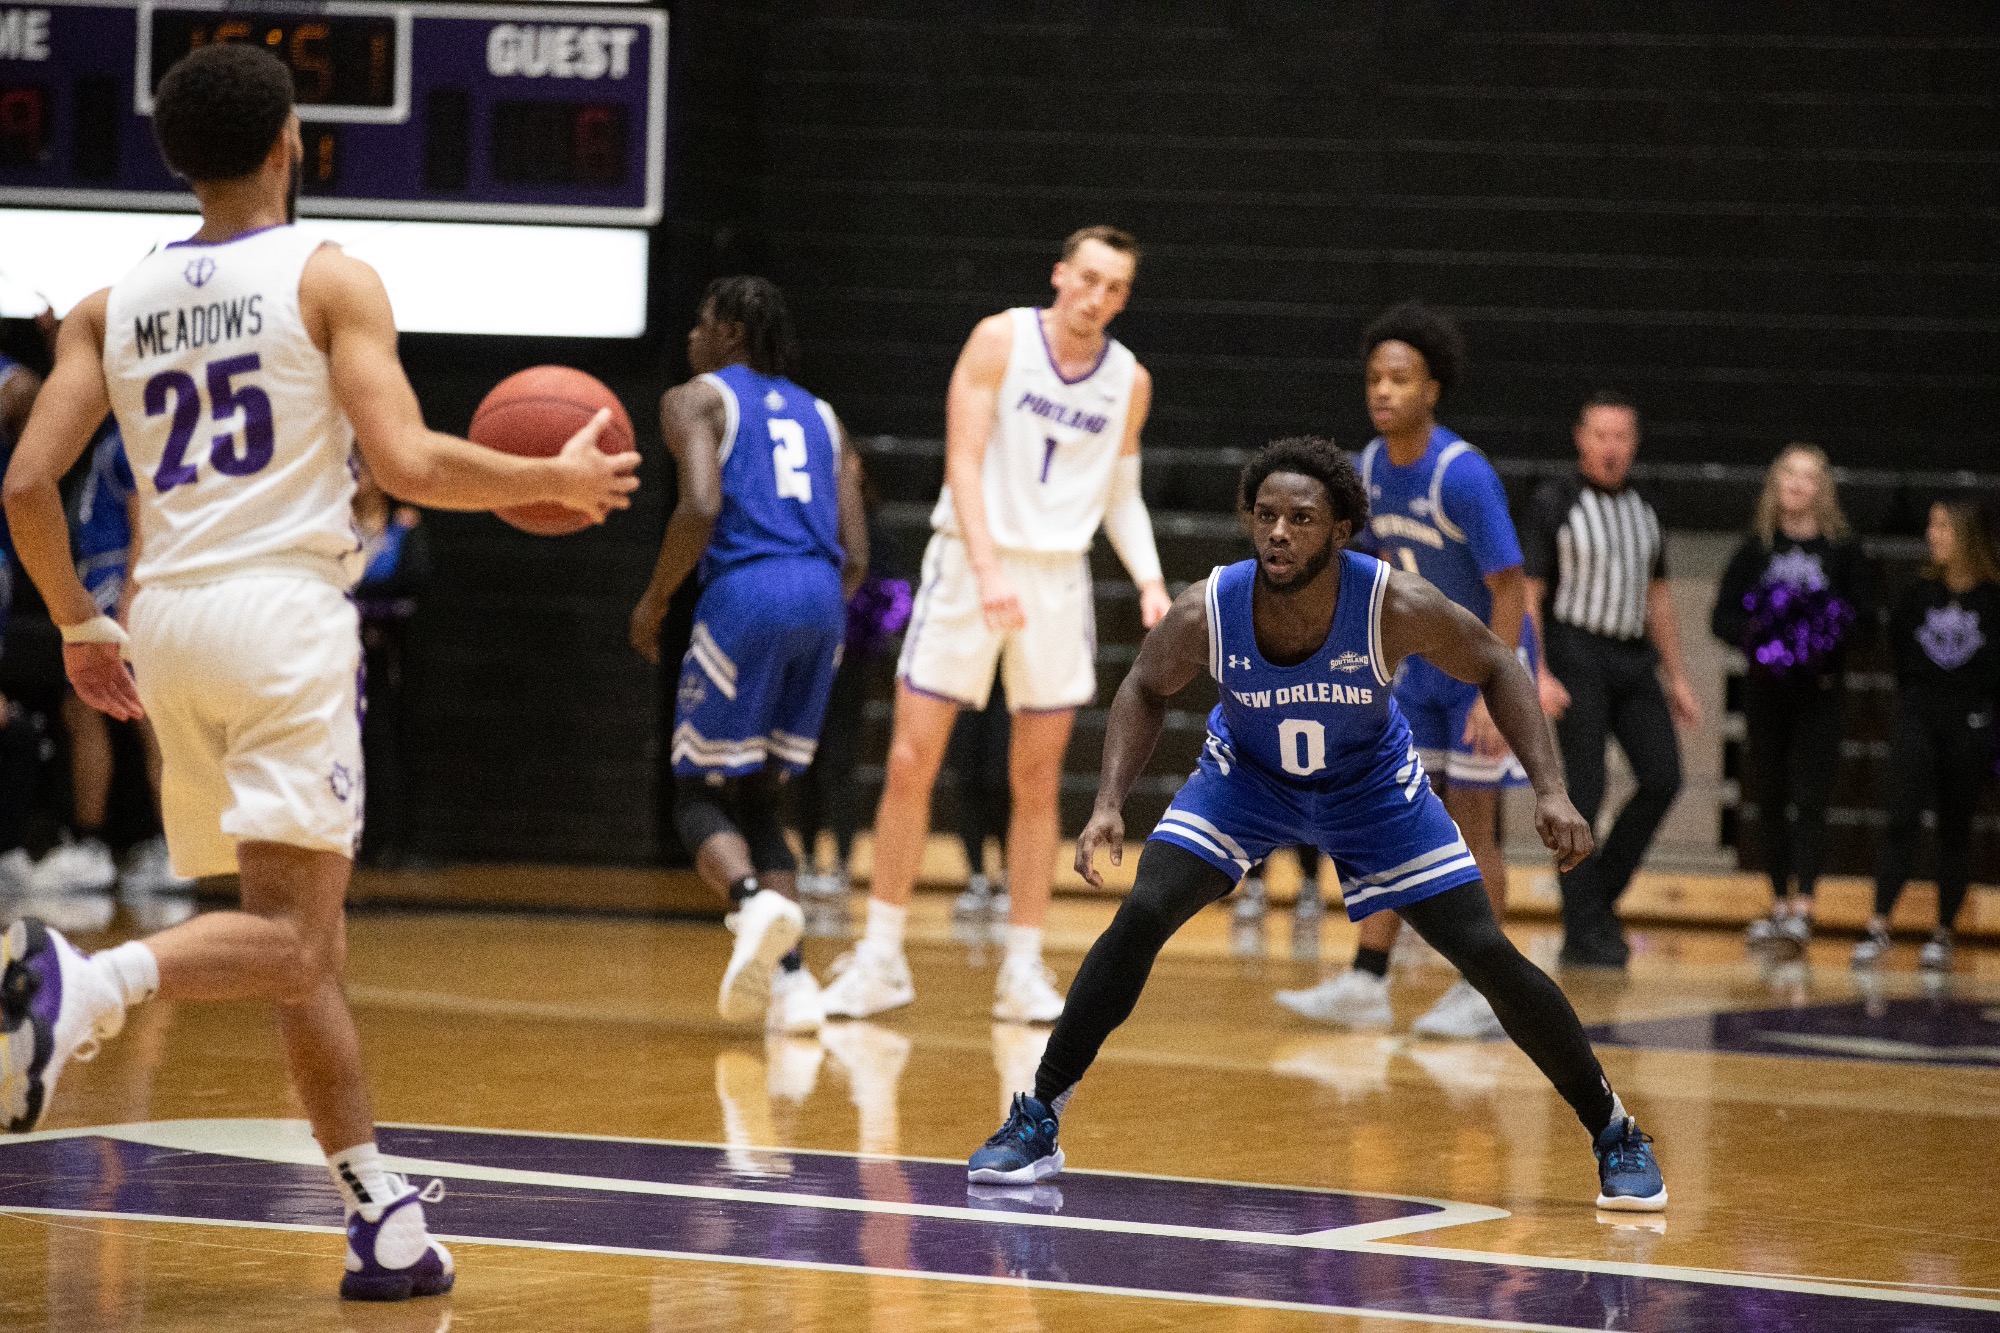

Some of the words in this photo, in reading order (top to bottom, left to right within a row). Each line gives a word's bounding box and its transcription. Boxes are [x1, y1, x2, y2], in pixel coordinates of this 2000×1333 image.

[486, 24, 638, 79] GUEST
[134, 294, 263, 359] MEADOWS
[143, 351, 276, 494] 25
[767, 418, 813, 505] 2
[1040, 436, 1058, 484] 1
[1275, 682, 1373, 705] ORLEANS
[1277, 718, 1327, 776] 0
